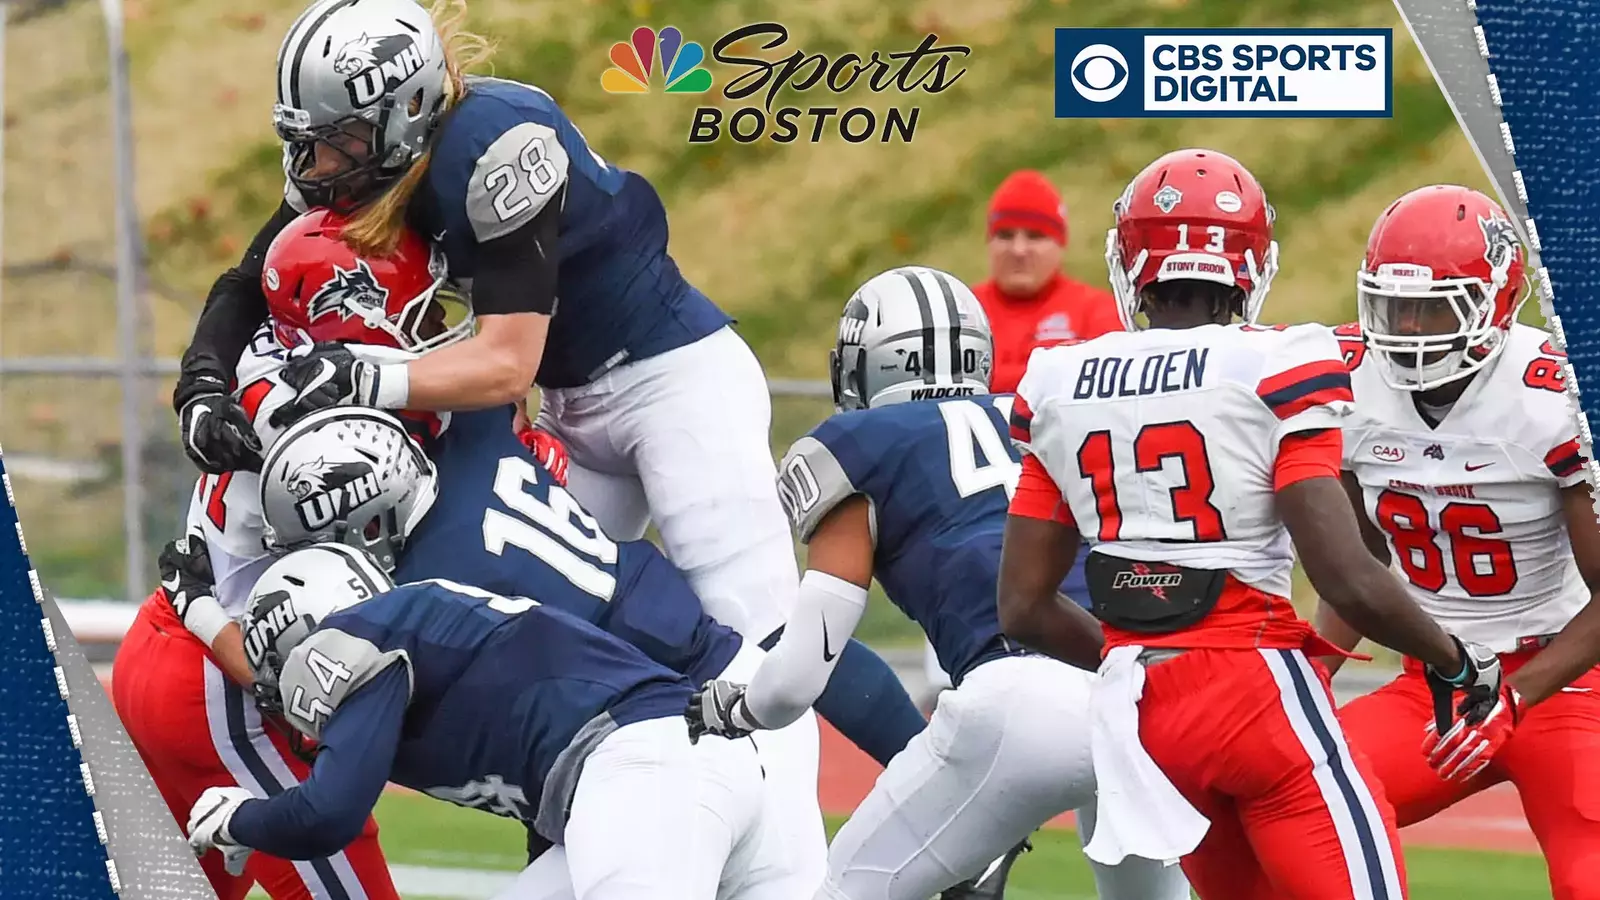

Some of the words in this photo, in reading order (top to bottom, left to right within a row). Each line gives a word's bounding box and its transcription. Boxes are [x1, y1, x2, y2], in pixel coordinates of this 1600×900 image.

[346, 42, 424, 109] UNH
[484, 137, 559, 222] 28
[1166, 262, 1195, 272] STONY
[1198, 262, 1226, 274] BROOK
[904, 351, 921, 376] 4
[910, 387, 975, 401] WILDCATS
[1073, 348, 1209, 399] BOLDEN
[938, 399, 1023, 499] 4
[1076, 420, 1228, 544] 13
[1372, 445, 1400, 458] CAA
[295, 472, 381, 531] UNH
[482, 456, 618, 603] 16
[1376, 489, 1518, 597] 86
[1113, 571, 1182, 589] POWER
[243, 599, 297, 670] UNH
[289, 648, 353, 725] 54
